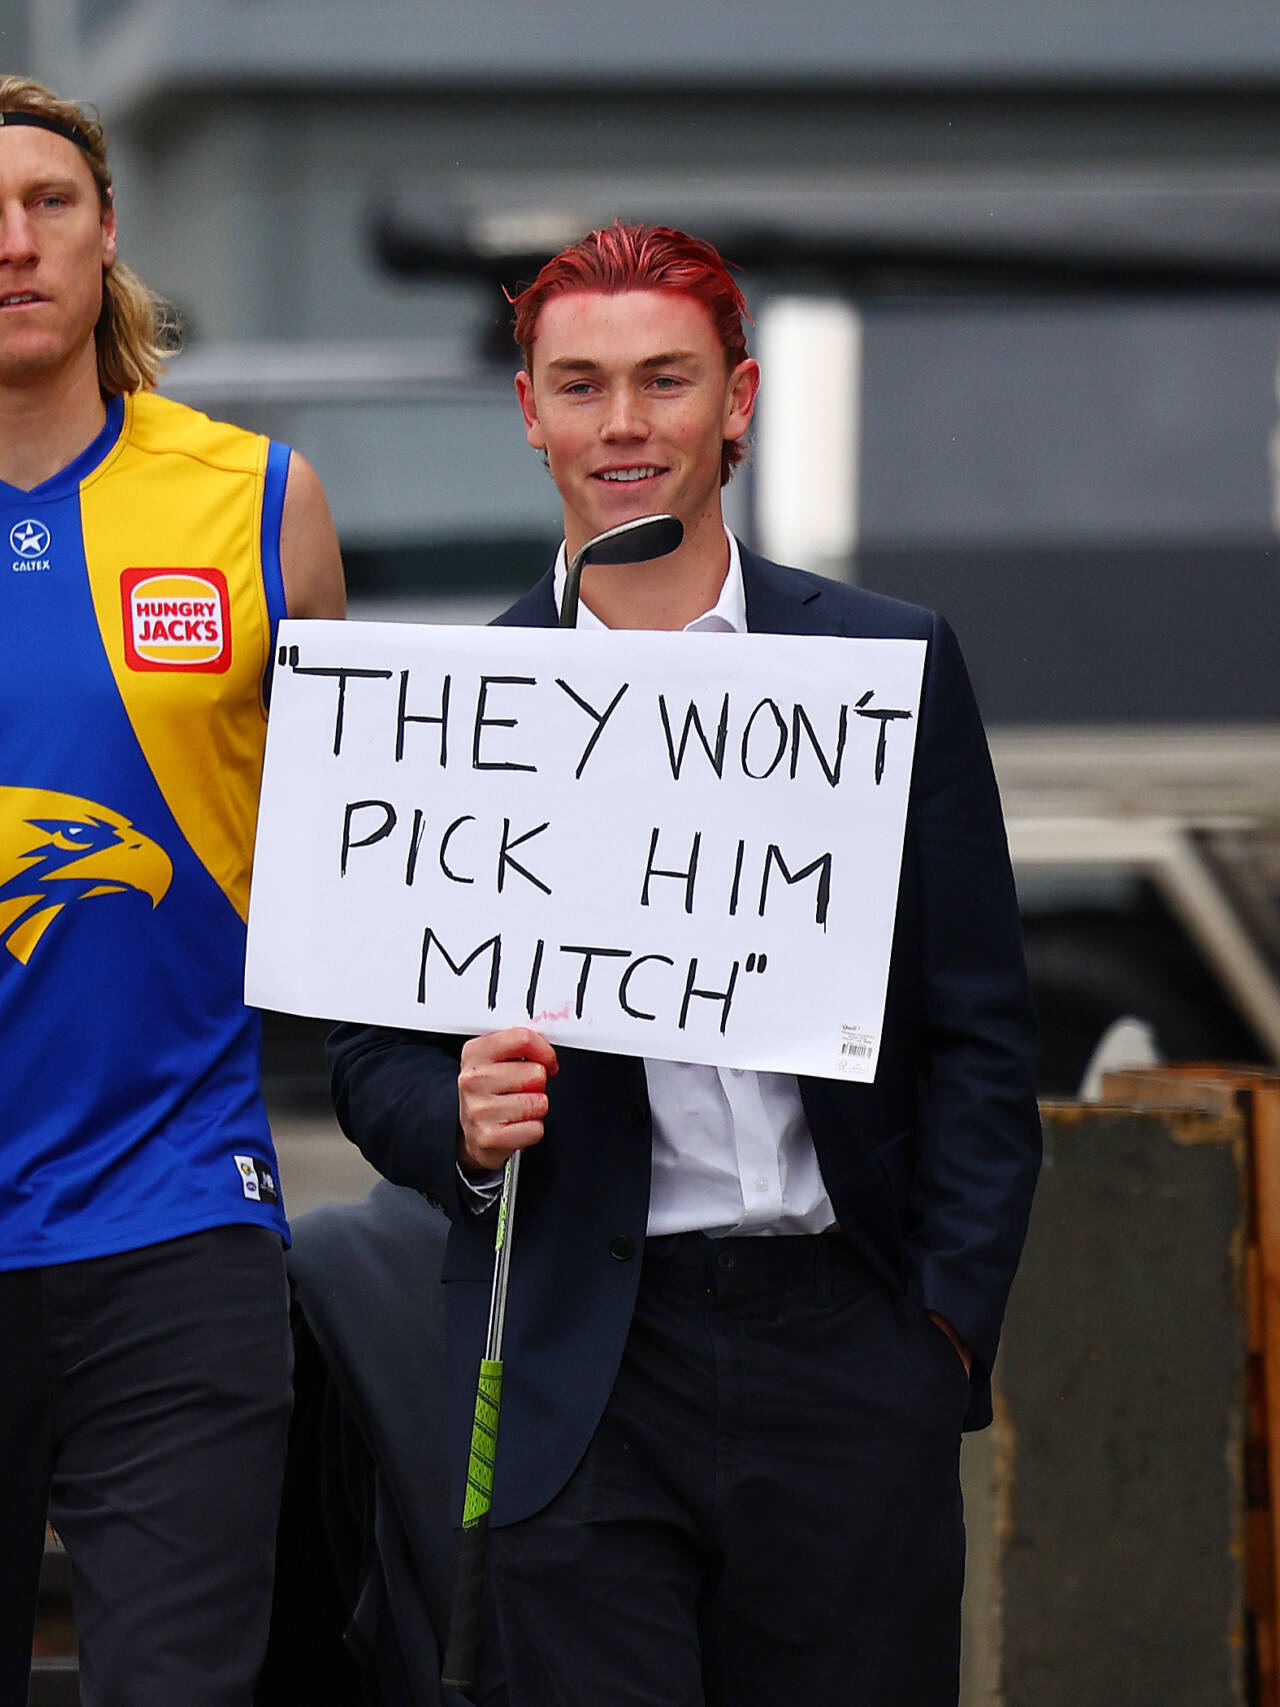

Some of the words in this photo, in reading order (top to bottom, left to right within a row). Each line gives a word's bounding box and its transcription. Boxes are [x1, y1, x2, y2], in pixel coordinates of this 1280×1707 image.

[12, 560, 50, 572] CALTEX
[136, 602, 216, 617] HUNGRY
[138, 620, 219, 641] JACK'S
[659, 690, 912, 788] WON'T
[341, 800, 551, 895] PICK
[641, 828, 831, 933] HIM
